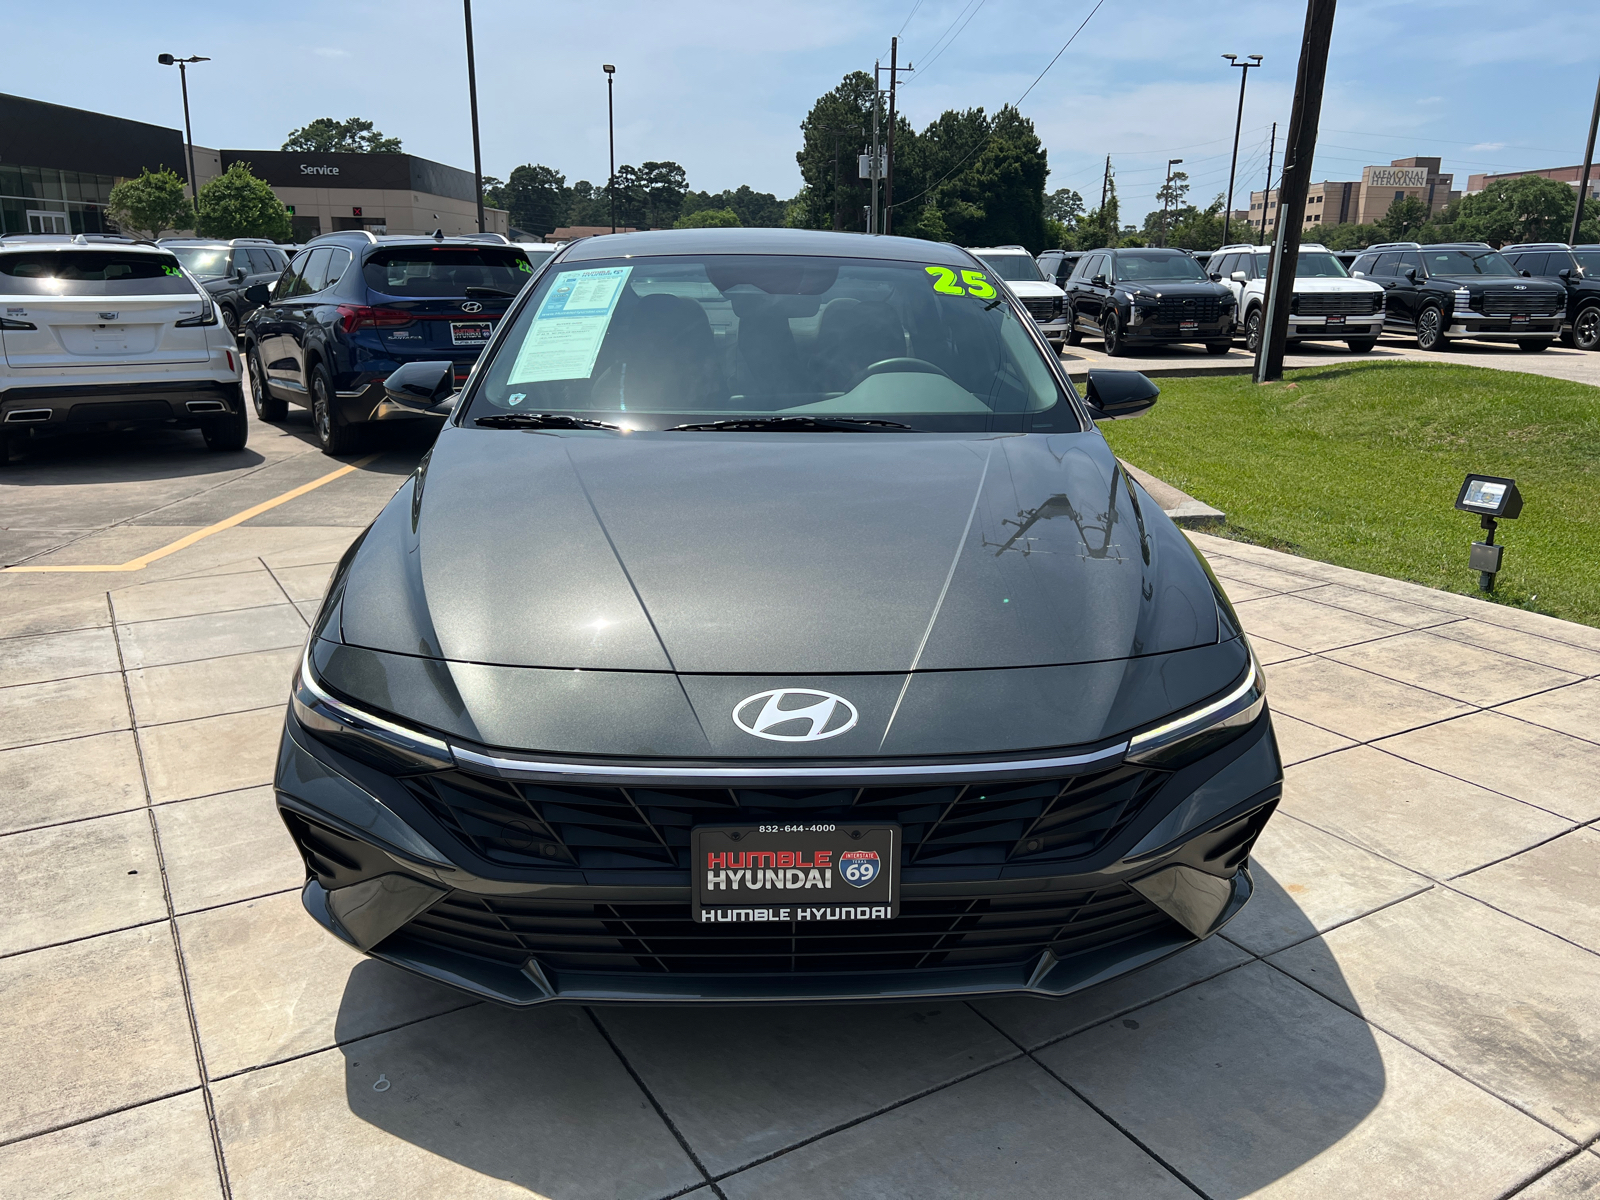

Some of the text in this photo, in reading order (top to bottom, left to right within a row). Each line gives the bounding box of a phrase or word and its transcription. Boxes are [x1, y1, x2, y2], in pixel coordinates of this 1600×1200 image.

[300, 164, 340, 175] Service
[1372, 170, 1424, 179] MEMORIAL
[1371, 177, 1425, 186] HERMANN
[162, 265, 182, 278] 24
[515, 258, 533, 275] 22
[924, 266, 998, 300] 25
[758, 824, 836, 833] 832-644-4000
[707, 850, 833, 869] HUMBLE
[707, 868, 832, 891] HYUNDAI
[845, 863, 874, 881] 69
[701, 906, 892, 922] HUMBLE HYUNDAI
